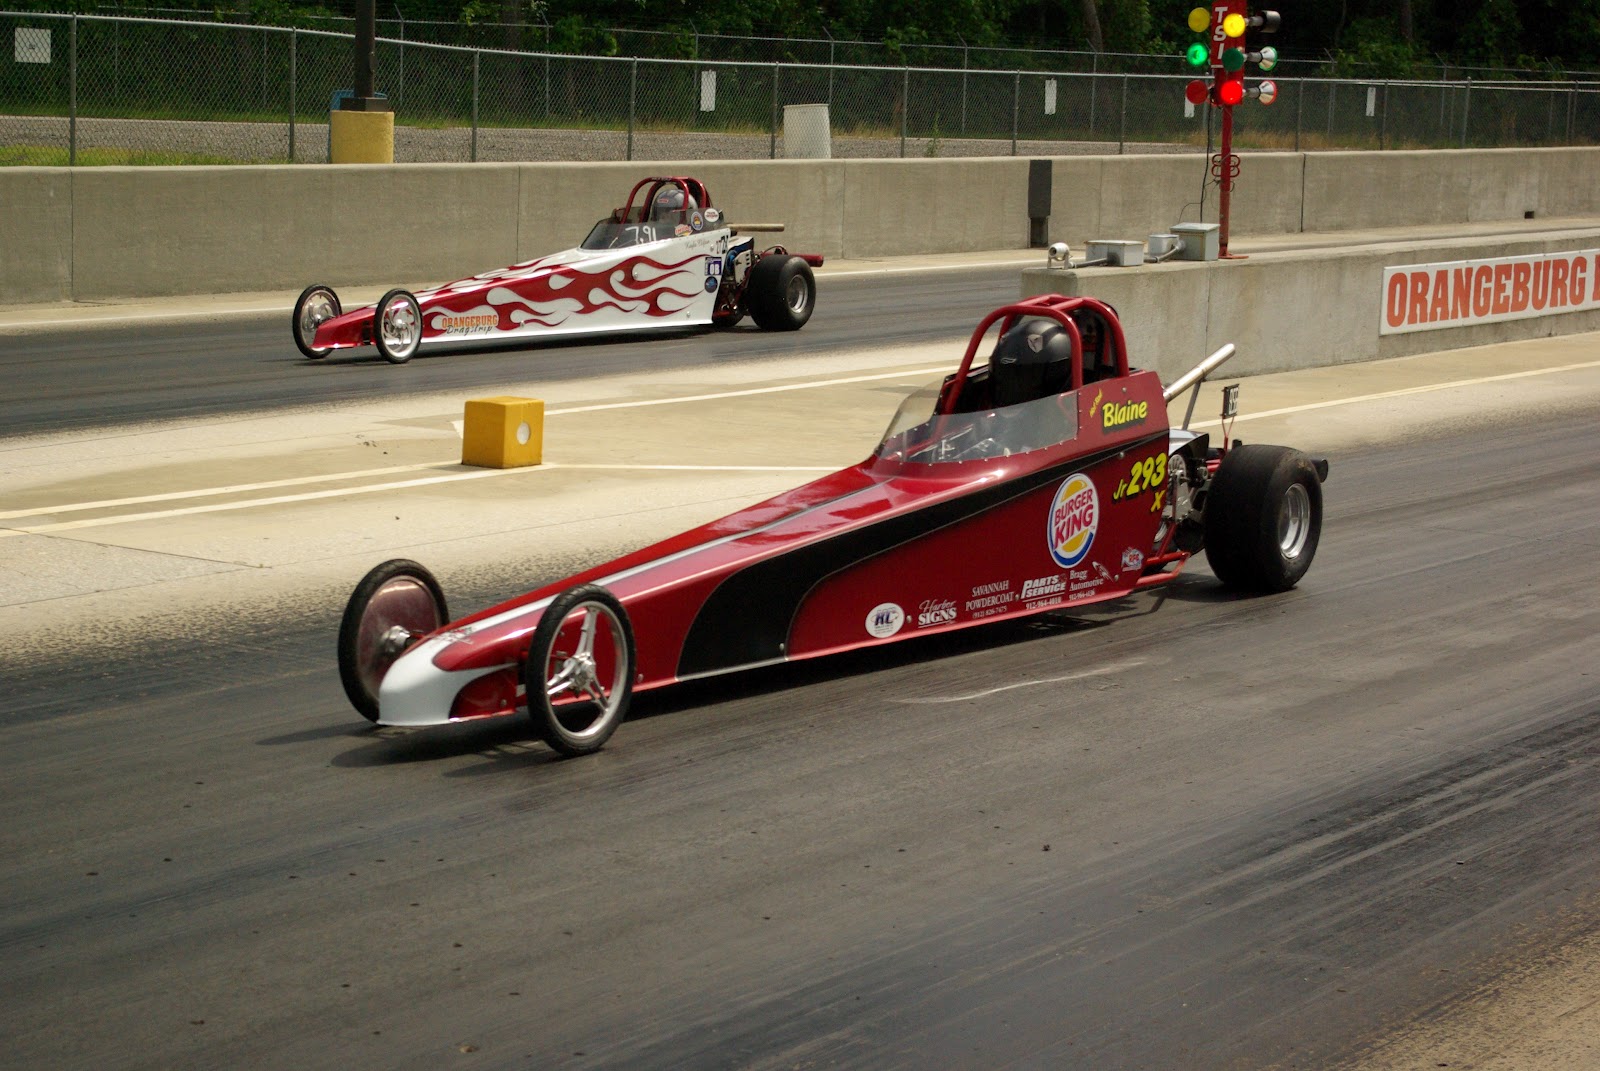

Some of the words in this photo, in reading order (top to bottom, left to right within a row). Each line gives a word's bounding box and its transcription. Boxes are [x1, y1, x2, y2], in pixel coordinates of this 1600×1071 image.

[1387, 256, 1587, 328] ORANGEBURG
[442, 314, 498, 329] ORANGEBURG
[1102, 400, 1147, 427] Blaine
[1126, 452, 1167, 496] 293
[1054, 488, 1093, 527] BURGER
[1054, 503, 1094, 550] KING
[971, 579, 1010, 597] SAVANNAH
[1021, 574, 1060, 599] PARTS
[1026, 582, 1066, 598] SERVICE
[1069, 577, 1104, 592] Automotive
[965, 591, 1014, 611] POWDERCOAT
[918, 607, 957, 625] SIGNS
